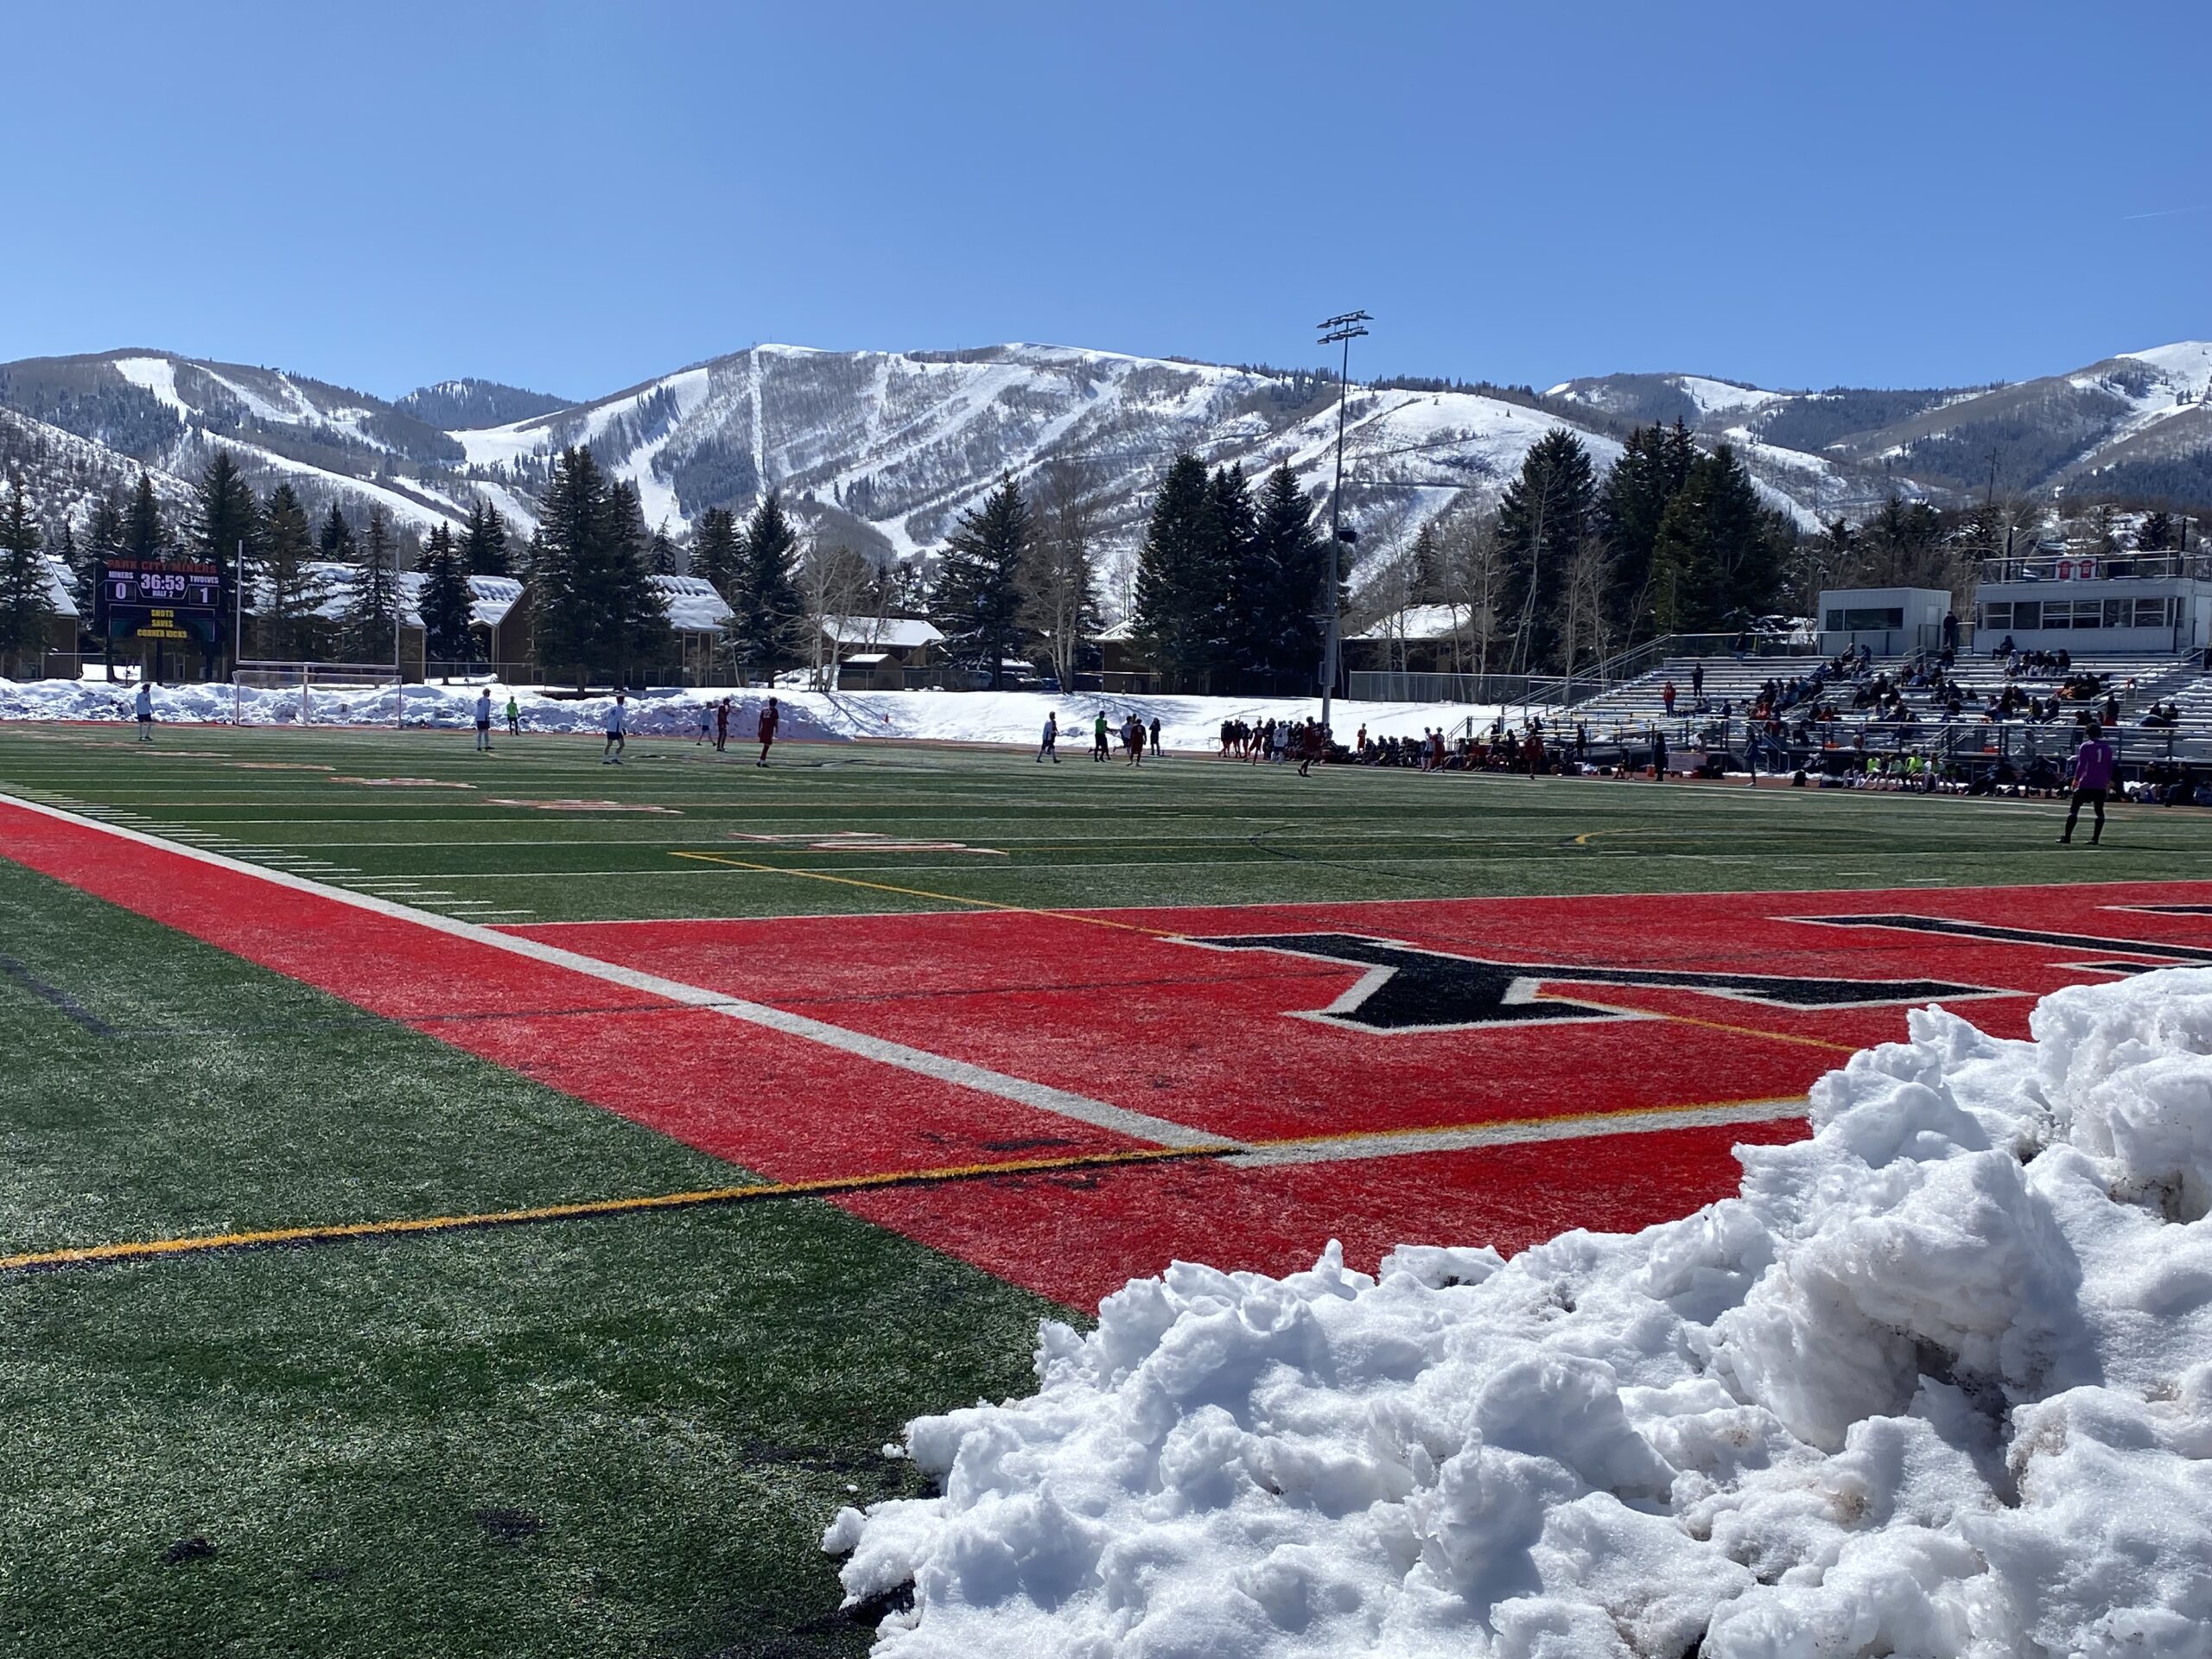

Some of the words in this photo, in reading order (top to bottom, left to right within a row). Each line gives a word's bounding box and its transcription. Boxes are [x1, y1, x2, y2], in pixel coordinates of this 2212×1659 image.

[107, 559, 137, 569] PARK
[141, 561, 167, 571] CITY
[170, 563, 217, 574] MINERS
[141, 574, 185, 591] 36:53
[115, 582, 126, 600] 0
[200, 588, 208, 603] 1
[2096, 747, 2102, 763] 1
